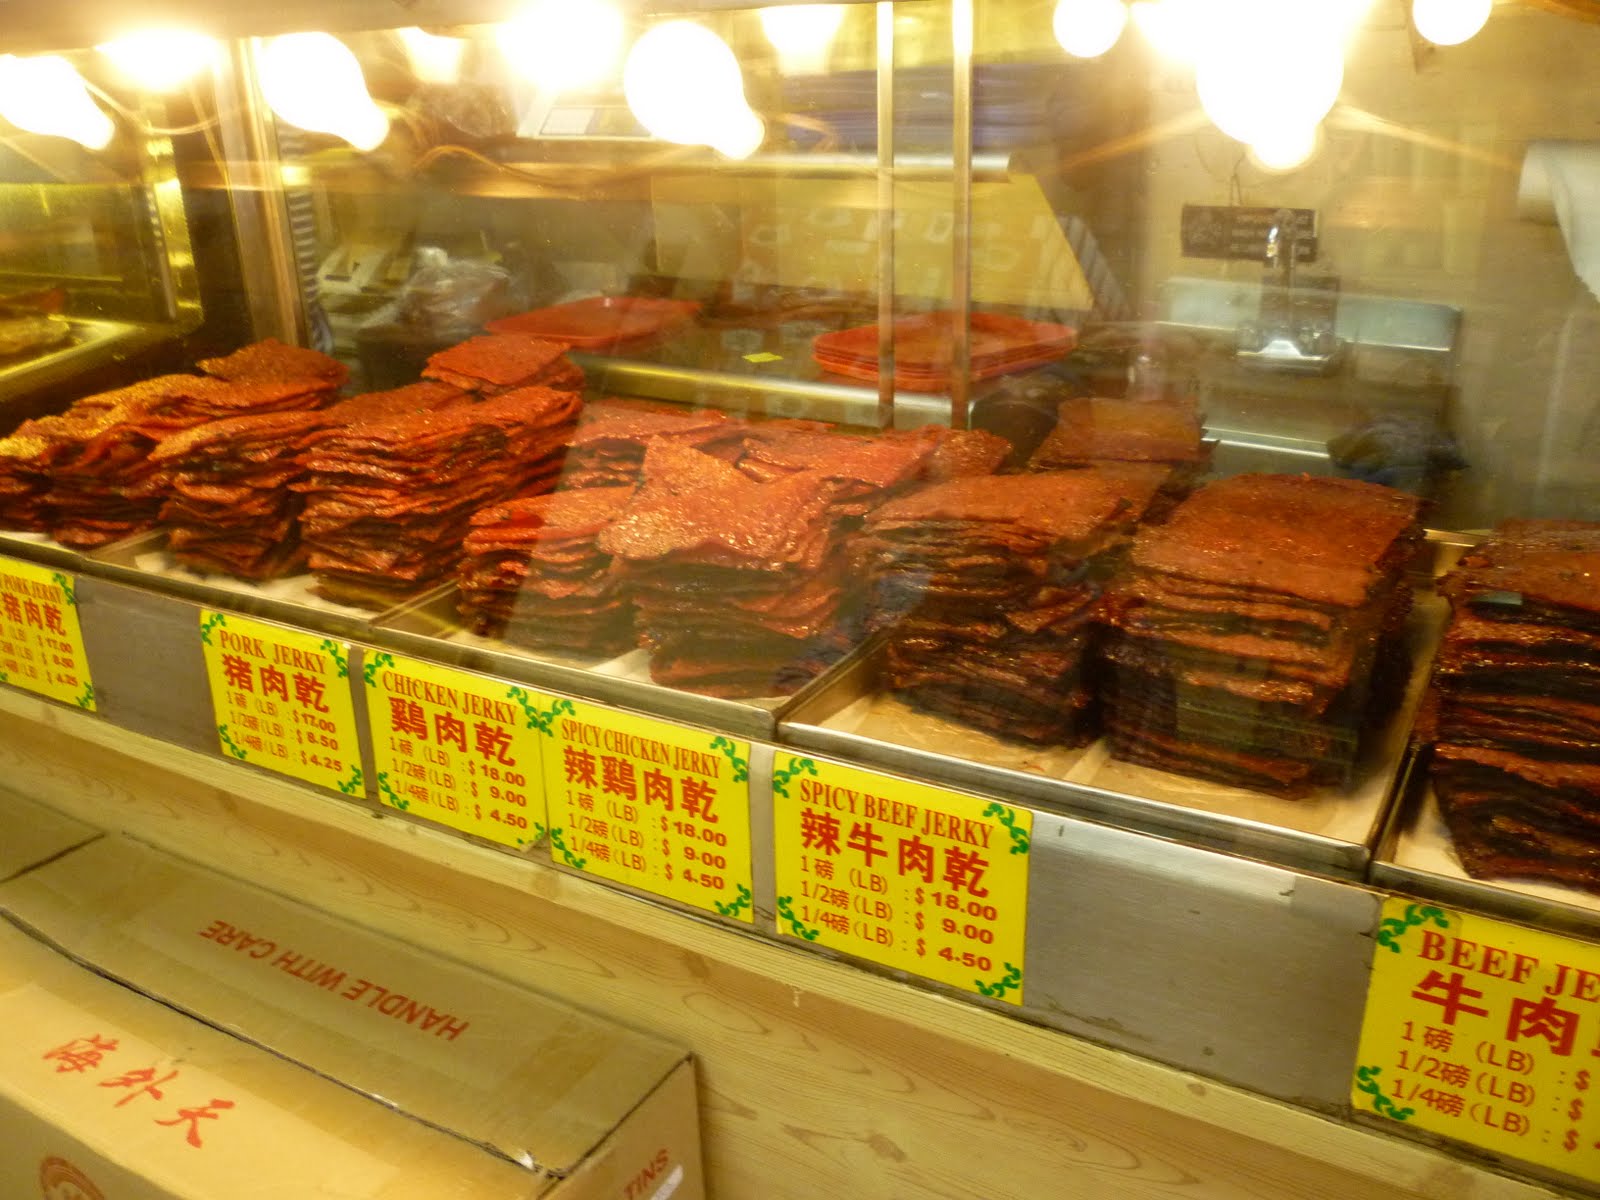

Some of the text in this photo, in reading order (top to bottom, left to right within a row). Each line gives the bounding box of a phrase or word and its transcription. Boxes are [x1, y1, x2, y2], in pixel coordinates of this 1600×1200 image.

[0, 592, 66, 636] 猪肉乾
[220, 629, 326, 674] PORK JERKY
[222, 653, 329, 713] 猪肉乾
[383, 671, 518, 726] CHICKEN JERKY
[562, 718, 721, 779] SPICY CHICKEN JERKY
[800, 778, 994, 849] SPICY BEEF JERKY
[801, 807, 990, 898] 辣牛肉乾
[197, 919, 470, 1041] HANDLE WITH CARE
[1417, 928, 1540, 985] BEEF
[1411, 969, 1600, 1058] 牛肉
